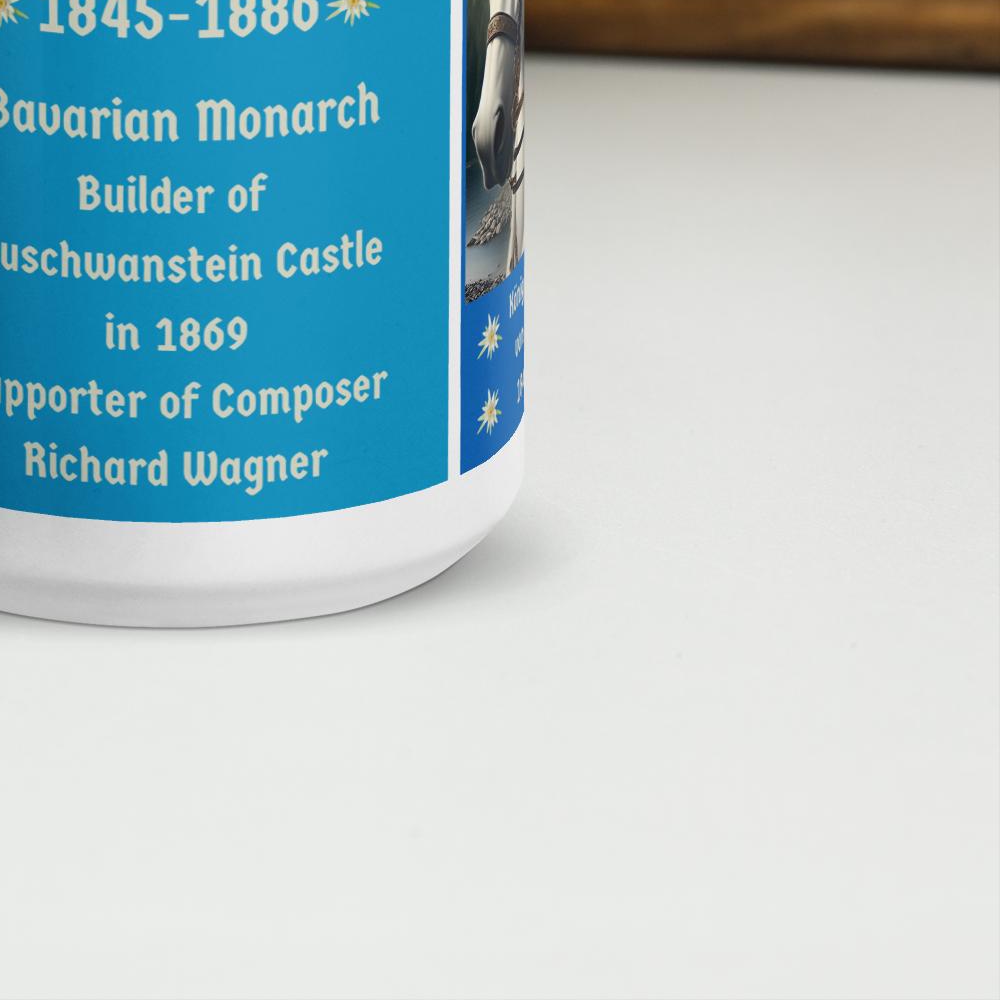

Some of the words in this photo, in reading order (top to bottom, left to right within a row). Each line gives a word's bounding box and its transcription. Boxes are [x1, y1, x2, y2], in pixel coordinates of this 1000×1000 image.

[196, 82, 380, 141] Monarch
[78, 175, 214, 214] Builder
[228, 173, 268, 213] of
[277, 230, 383, 278] Castle
[106, 312, 140, 350] in
[156, 316, 248, 351] 1869
[160, 382, 201, 419] of
[213, 371, 388, 423] Composer
[24, 442, 168, 486] Richard
[184, 449, 328, 495] Wagner
